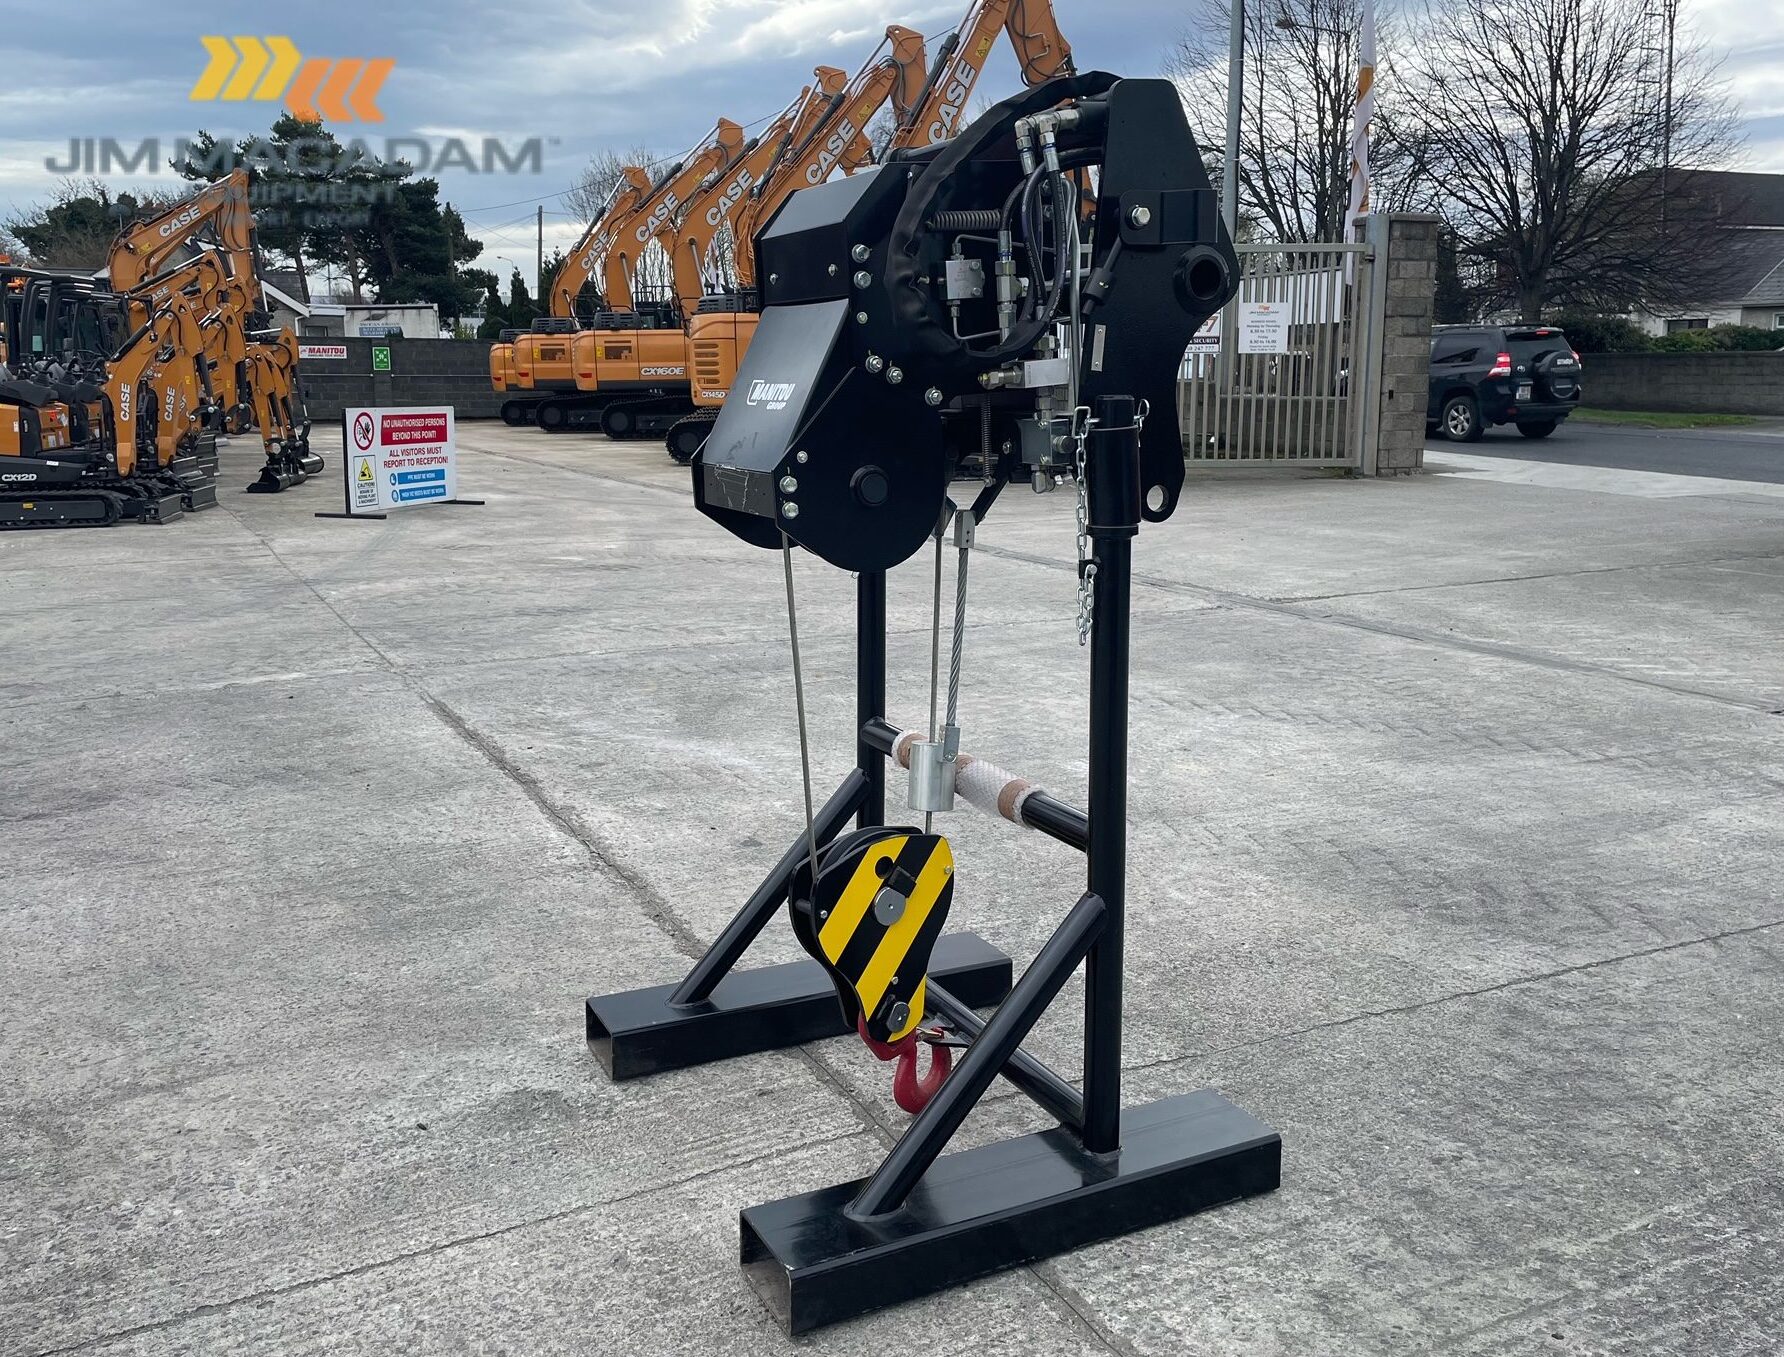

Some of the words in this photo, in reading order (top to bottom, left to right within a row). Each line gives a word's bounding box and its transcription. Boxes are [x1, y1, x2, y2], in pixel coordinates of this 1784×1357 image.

[928, 59, 976, 144] CASE
[805, 118, 856, 184] CASE
[705, 168, 754, 226] CASE
[159, 205, 201, 237] CASE
[635, 192, 679, 242] CASE
[580, 230, 609, 270] CASE
[152, 286, 169, 300] ASE
[640, 366, 685, 376] CX160E
[751, 383, 796, 401] MANITOU
[120, 383, 131, 421] CASE
[164, 386, 175, 421] CASE
[766, 402, 787, 410] GROUP
[383, 419, 389, 428] NO
[391, 419, 424, 427] UNAUTHORISED
[425, 418, 445, 426] PERSONS
[392, 432, 410, 440] BEYOND
[411, 431, 421, 439] THIS
[401, 448, 425, 456] VISITORS
[384, 459, 406, 468] REPORT
[416, 456, 448, 466] RECEPTION!
[2, 473, 37, 481] CX12D
